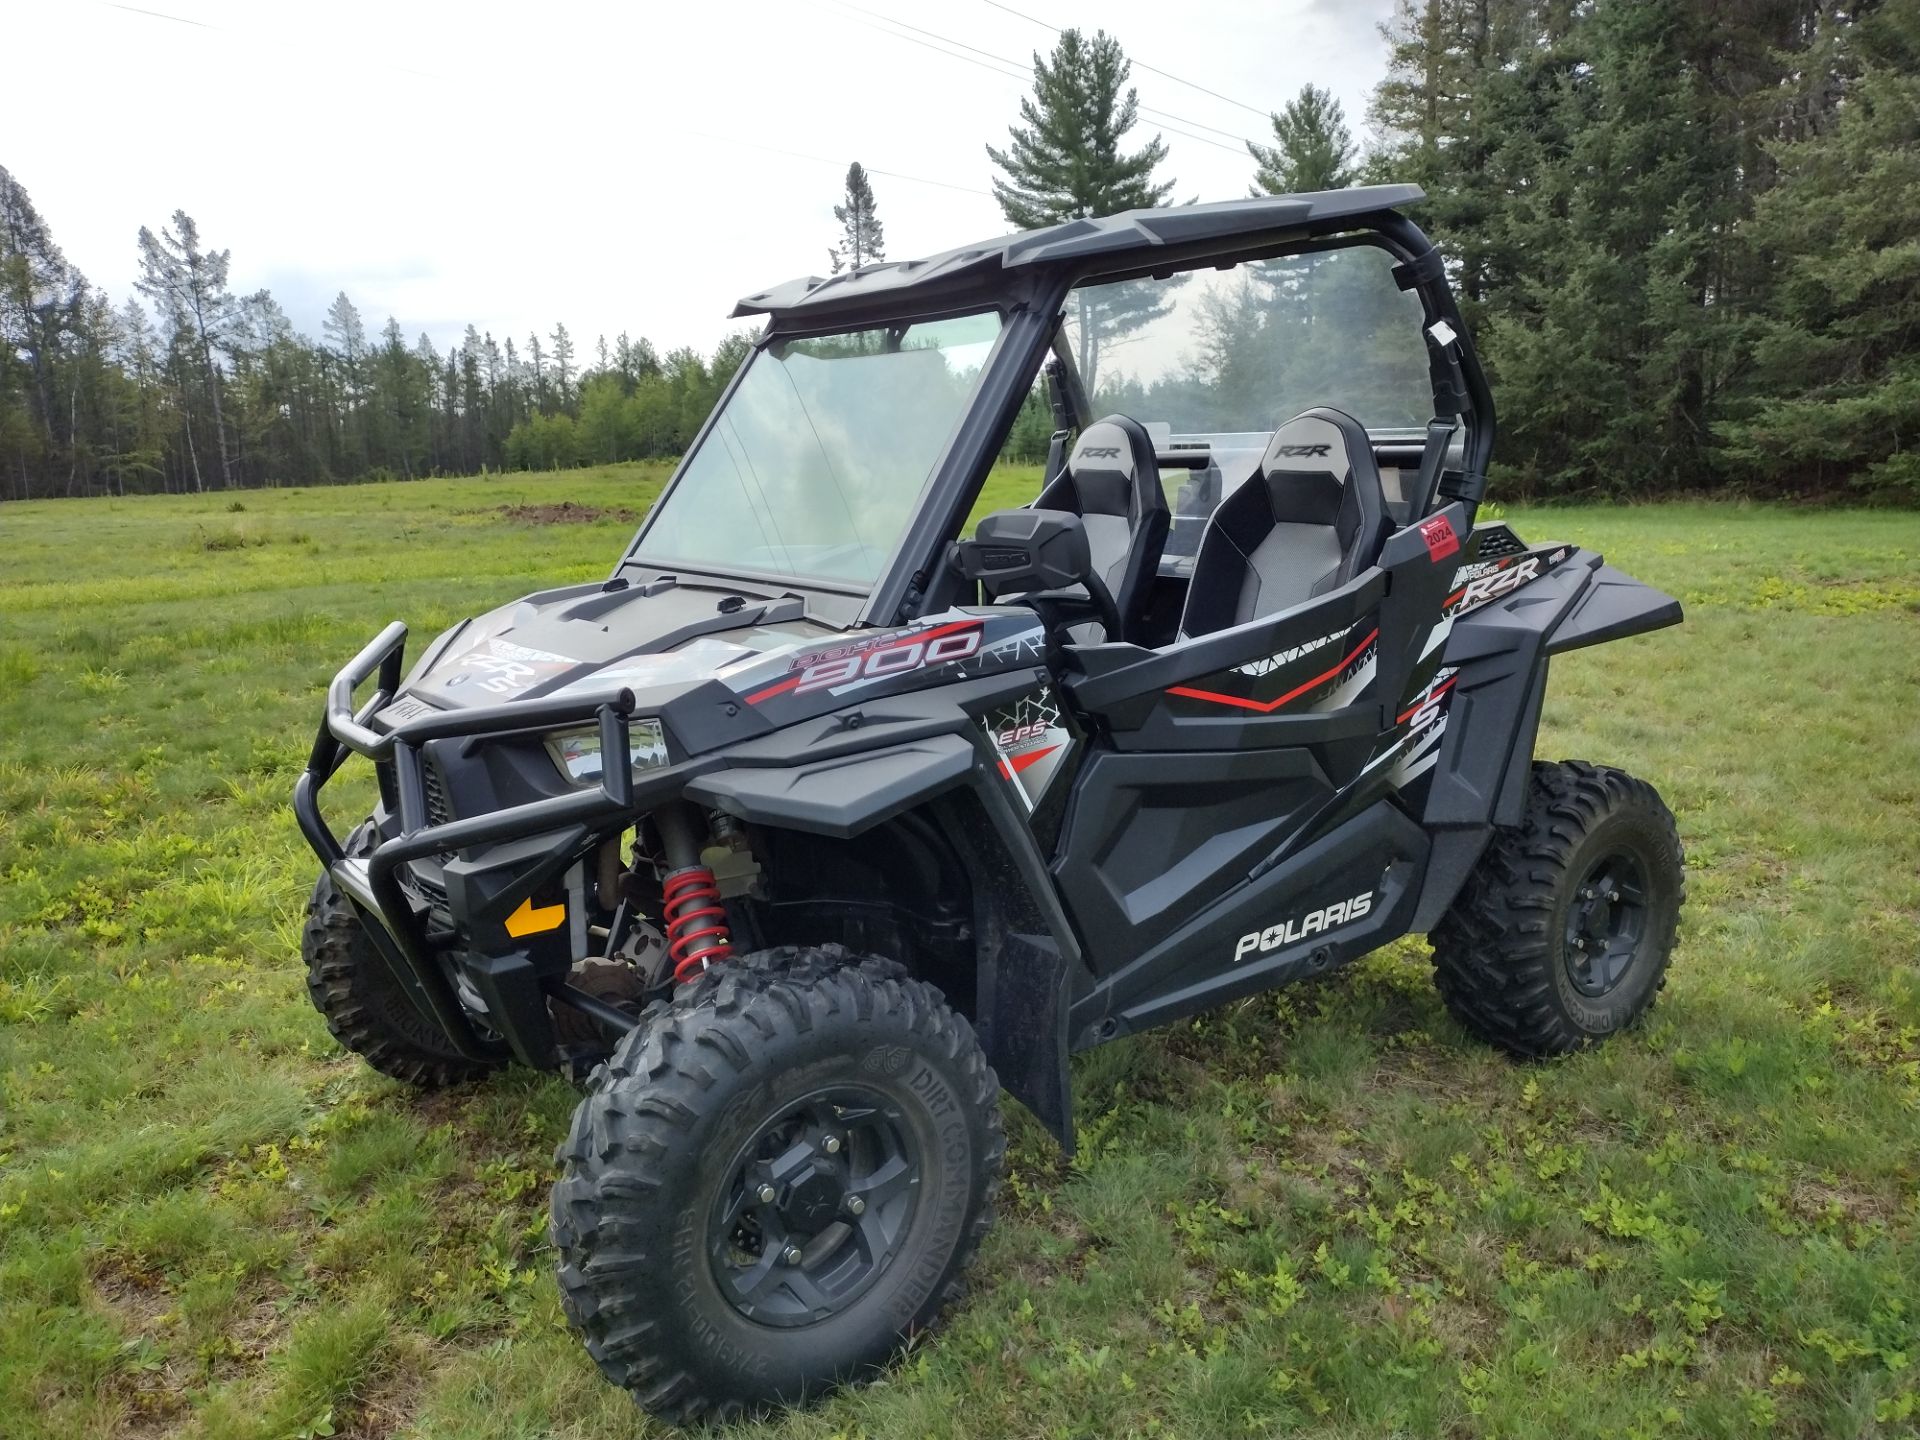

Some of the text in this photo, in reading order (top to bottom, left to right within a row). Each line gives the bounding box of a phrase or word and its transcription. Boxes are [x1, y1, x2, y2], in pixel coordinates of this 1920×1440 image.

[1078, 446, 1121, 459] RZR
[1273, 444, 1332, 459] RZR
[1427, 526, 1453, 546] 2024
[1460, 557, 1540, 610] RZR
[1468, 564, 1499, 580] POLARIS
[788, 633, 897, 671] DOHC
[792, 630, 983, 697] 900
[998, 720, 1048, 745] EPS
[1233, 890, 1374, 962] POLARIS
[896, 1066, 971, 1321] DIRT COMMANDER
